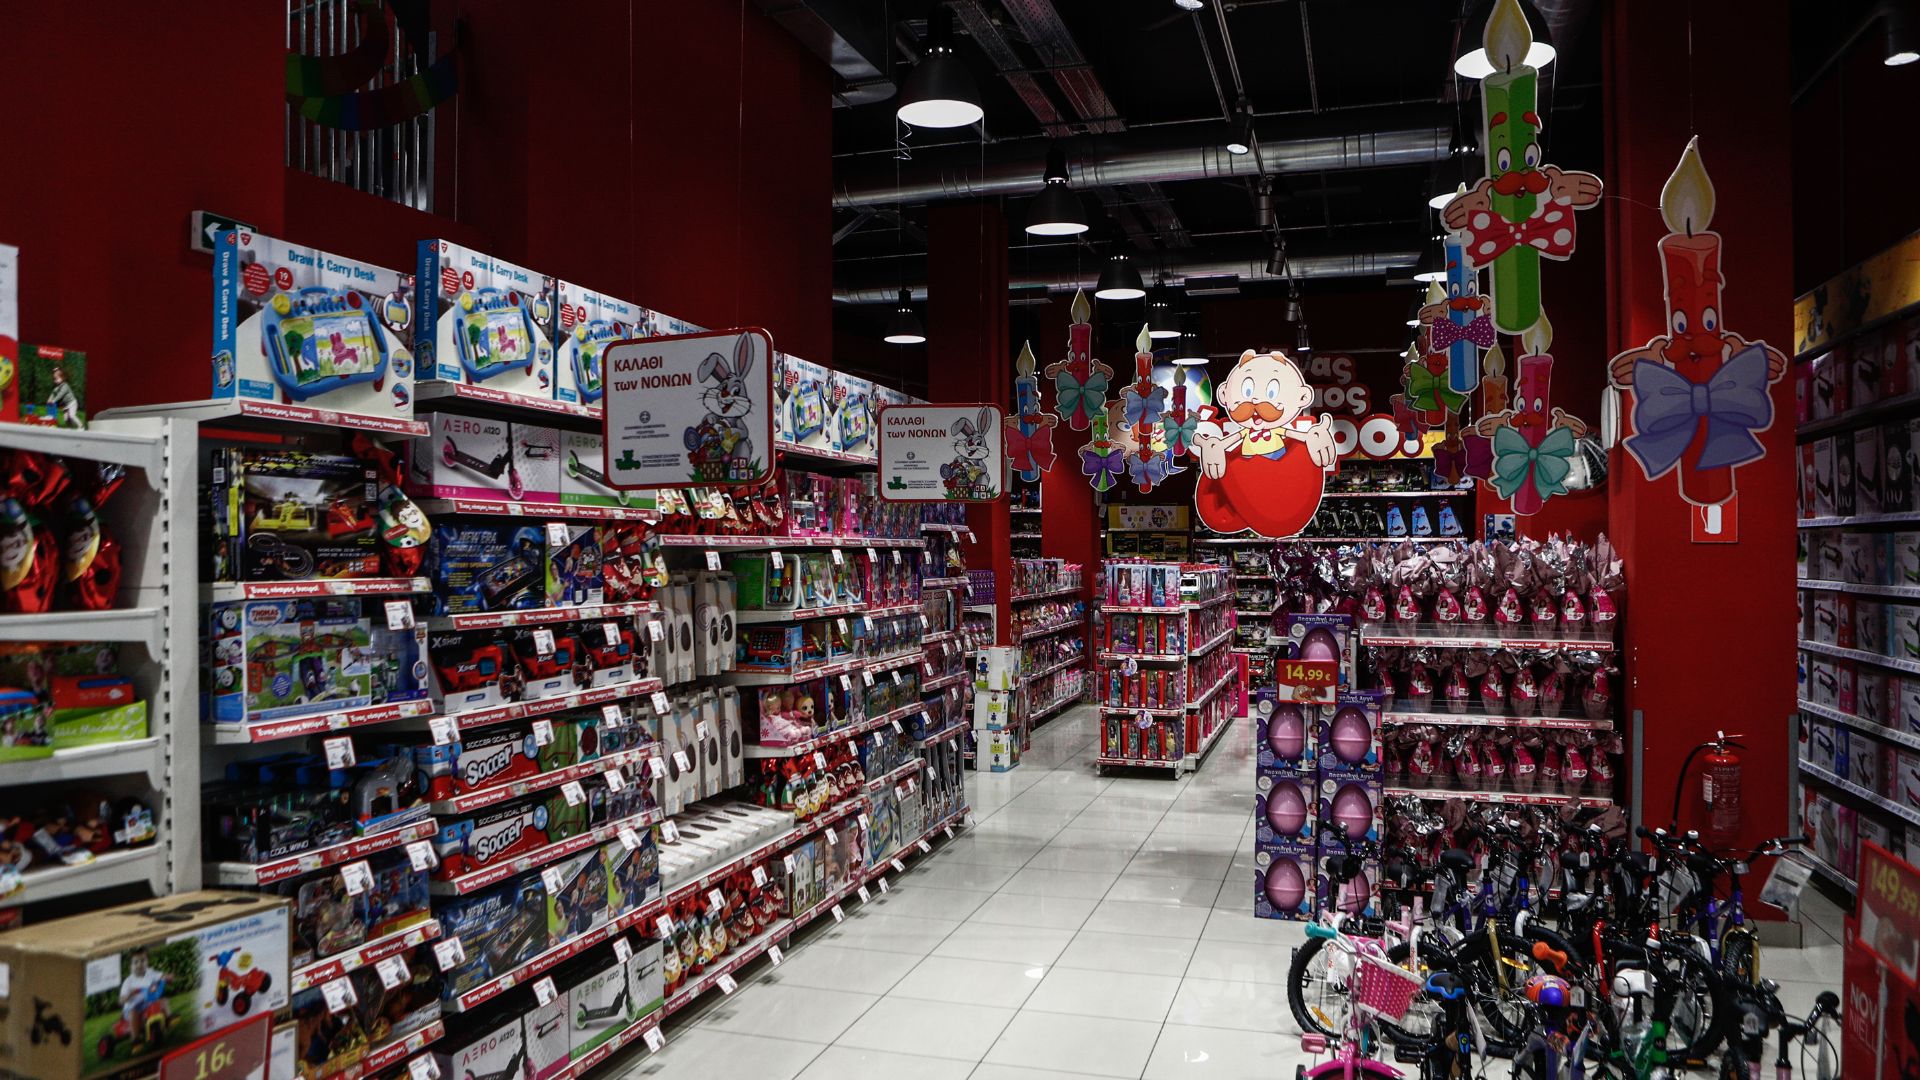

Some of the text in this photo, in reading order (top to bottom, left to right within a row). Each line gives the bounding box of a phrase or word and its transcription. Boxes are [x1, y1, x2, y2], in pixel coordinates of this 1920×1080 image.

[288, 250, 376, 282] Draw & Carry Desk
[424, 258, 432, 278] Draw
[472, 256, 528, 283] Draw & Carry Desk
[222, 252, 230, 340] Draw & Carry Desk
[424, 288, 432, 310] Carry
[424, 311, 432, 332] Desk
[614, 356, 663, 372] ΚΑΛΑΘΙ
[614, 373, 692, 391] των ΝΟΝΩΝ
[887, 416, 925, 426] ΚΑΛΑΘΙ
[908, 429, 946, 438] ΝΟΝΩΝ
[466, 738, 492, 750] SOCCER
[467, 744, 512, 786] Soccer
[478, 814, 503, 826] SOCCER
[476, 820, 523, 862] Soccer
